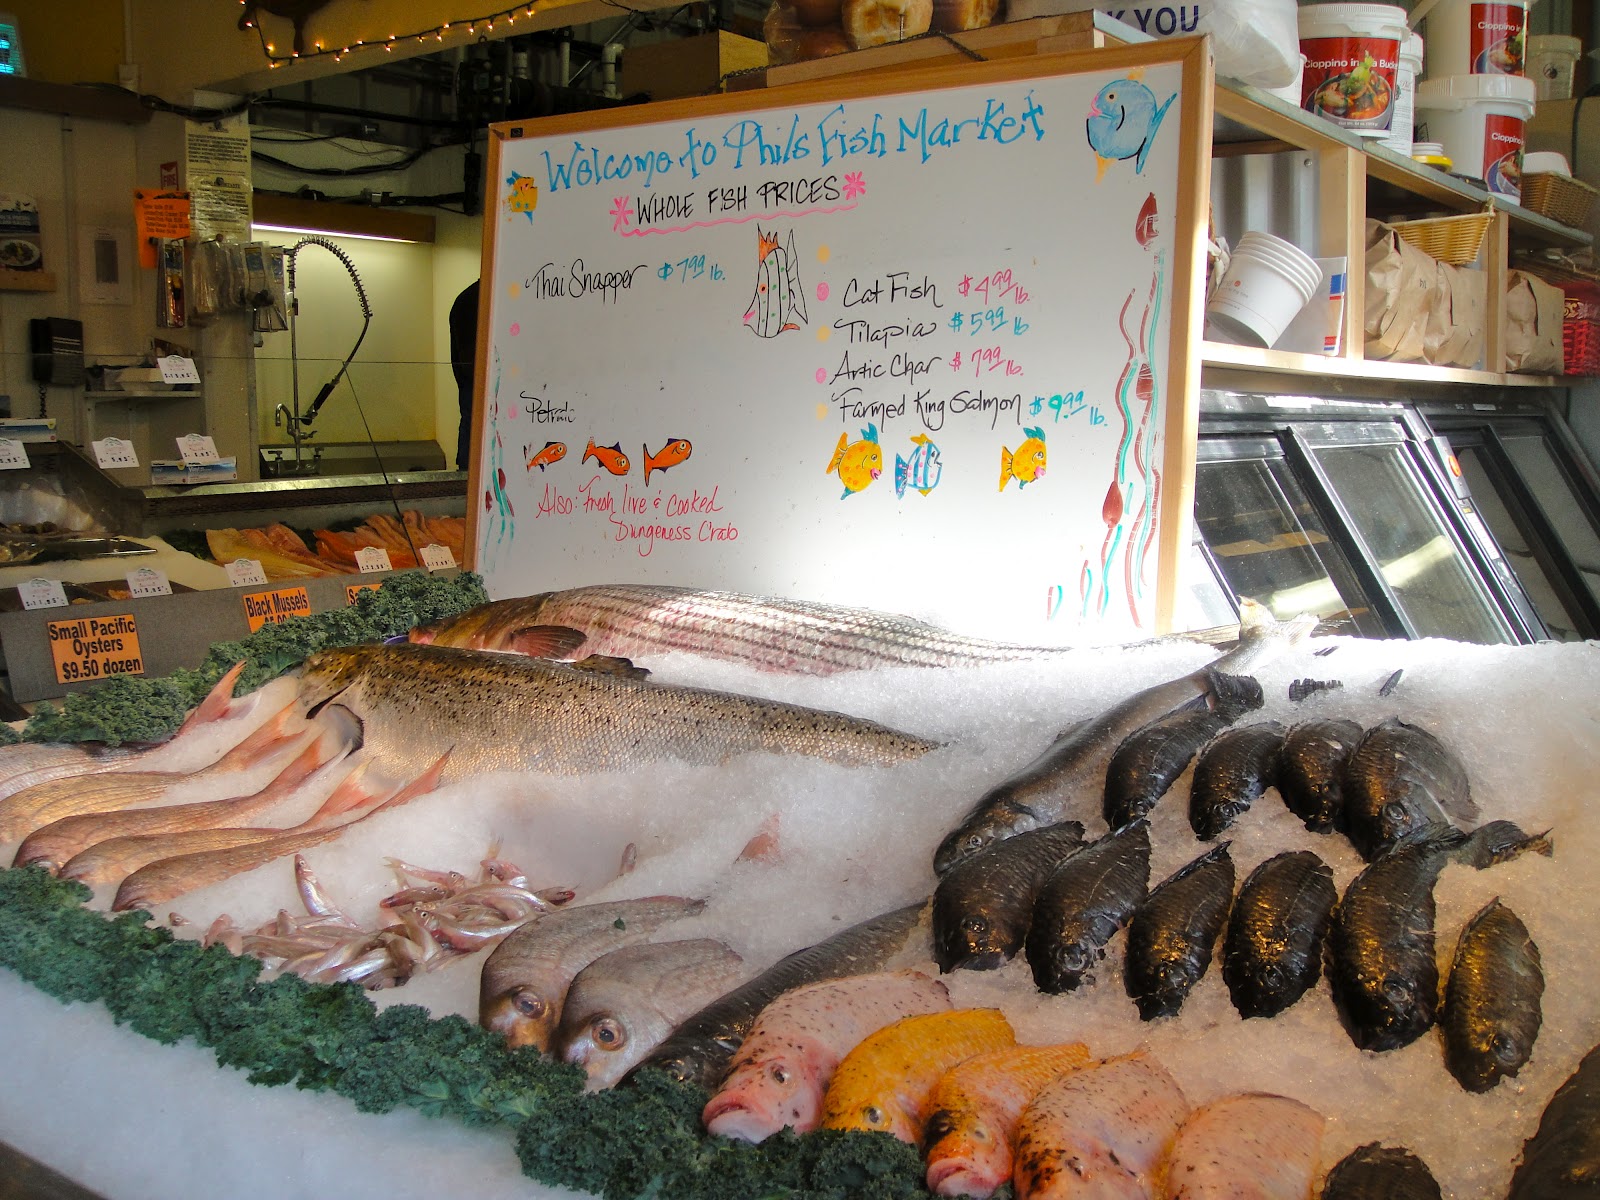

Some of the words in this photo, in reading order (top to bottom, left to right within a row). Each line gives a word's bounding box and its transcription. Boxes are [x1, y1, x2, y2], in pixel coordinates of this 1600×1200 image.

[1134, 5, 1199, 36] YOU
[1478, 21, 1516, 31] Cioppino
[1304, 58, 1349, 69] Cioppino
[540, 141, 674, 193] Welcome
[678, 128, 717, 179] to
[817, 104, 887, 167] Fish
[896, 90, 1045, 164] Market
[1491, 132, 1522, 144] Cioppino
[636, 193, 695, 225] WHOLE
[707, 187, 748, 214] FISH
[756, 176, 841, 208] PRICES
[525, 262, 566, 299] Thai
[568, 258, 648, 304] Snapper
[843, 278, 885, 308] Cat
[886, 272, 943, 308] Fish
[834, 318, 937, 349] Tilapia
[829, 350, 886, 385] Artic
[890, 352, 942, 385] Char
[831, 387, 906, 432] Farmed
[913, 389, 946, 431] King
[949, 389, 1022, 431] Salmon
[578, 475, 616, 514] Fresh
[622, 484, 648, 515] live
[609, 511, 692, 557] Dungeness
[698, 520, 739, 542] Crab
[245, 595, 274, 618] Black
[272, 590, 308, 613] Mussels
[49, 621, 88, 641] Small
[90, 617, 136, 636] Pacific
[72, 638, 124, 659] Oysters
[62, 659, 99, 680] $9.50
[103, 657, 141, 675] dozen
